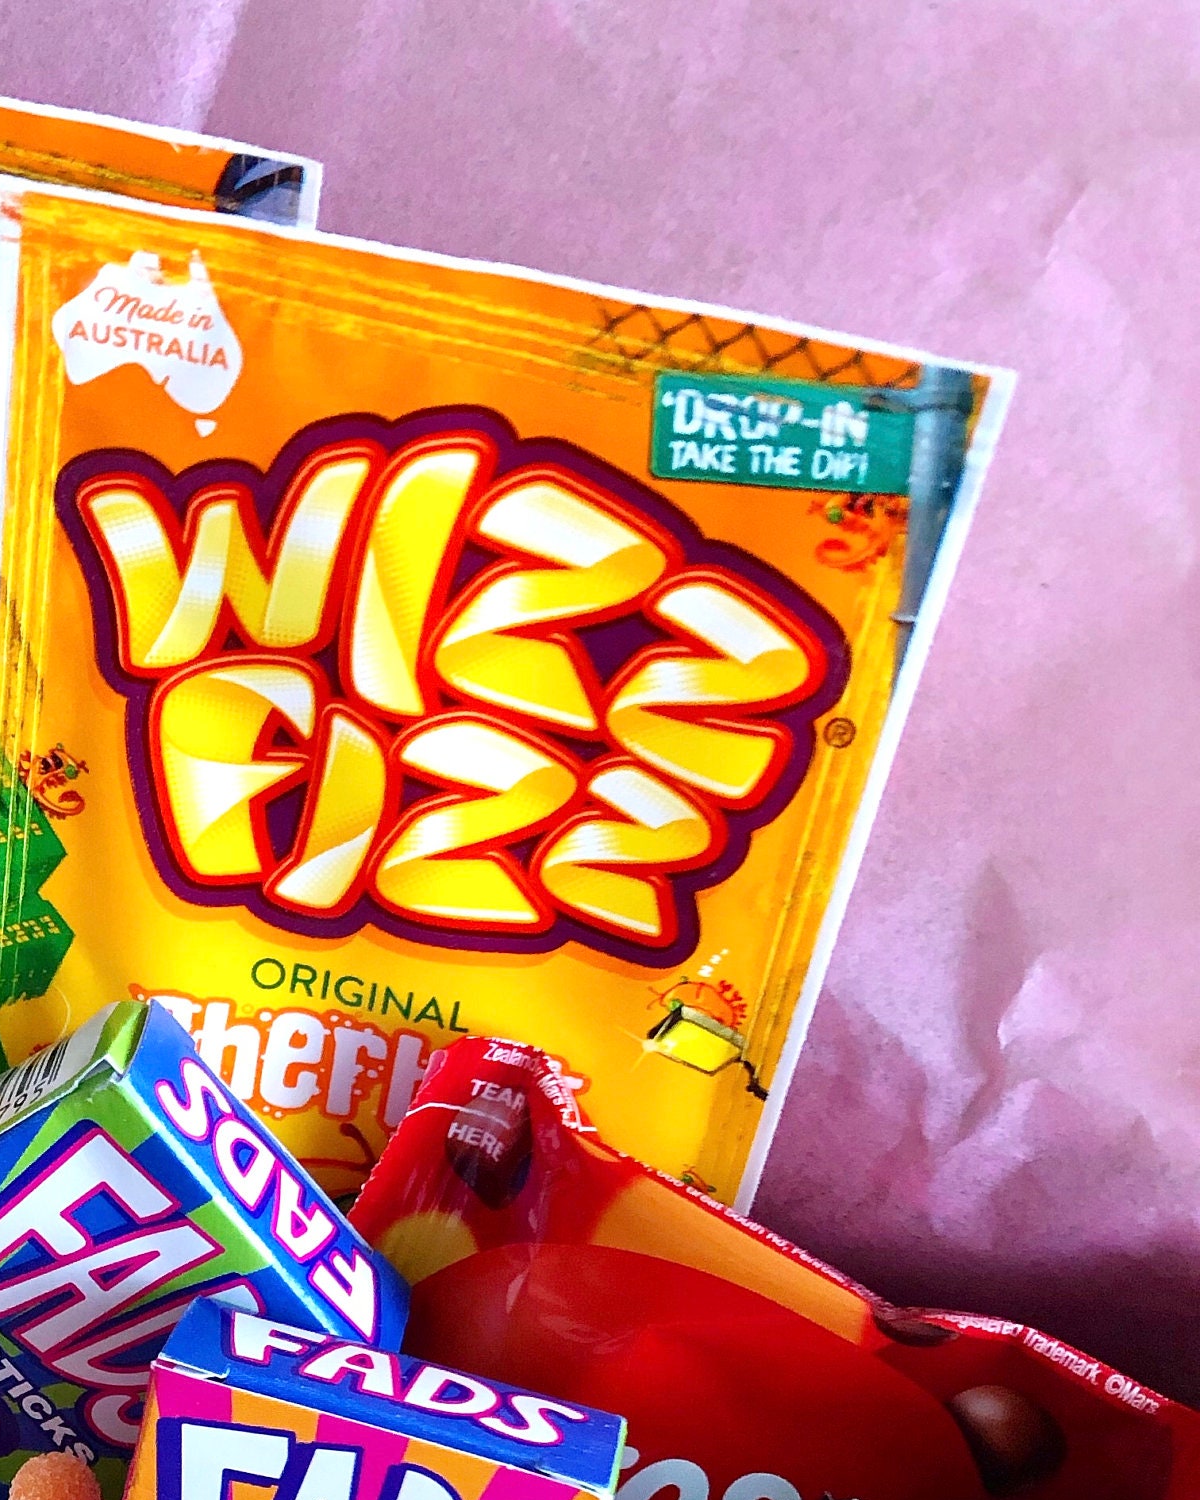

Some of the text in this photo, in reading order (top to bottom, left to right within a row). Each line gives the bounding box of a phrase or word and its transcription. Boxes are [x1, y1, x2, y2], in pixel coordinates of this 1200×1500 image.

[69, 320, 229, 370] AUSTRALIA
[94, 287, 216, 331] Made in
[669, 440, 738, 474] TAKE
[748, 444, 803, 476] THE
[75, 430, 826, 800] WIZZ
[146, 652, 728, 948] FIZZ
[250, 957, 469, 1034] ORIGINAL
[153, 1060, 382, 1342] FADS
[225, 1308, 589, 1450] FADS
